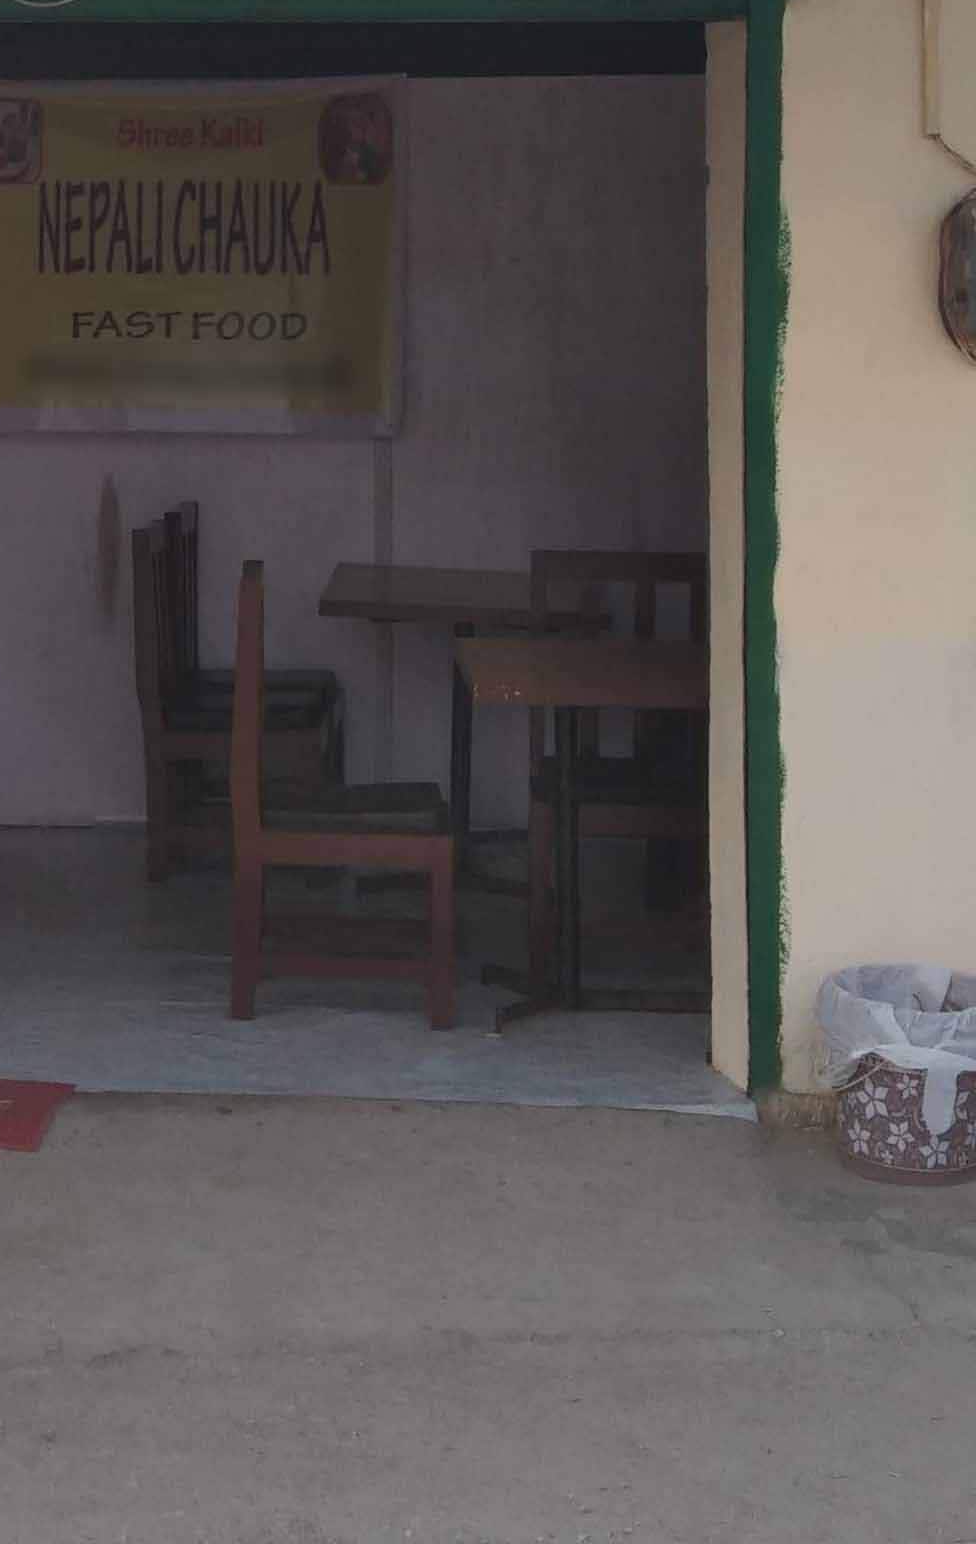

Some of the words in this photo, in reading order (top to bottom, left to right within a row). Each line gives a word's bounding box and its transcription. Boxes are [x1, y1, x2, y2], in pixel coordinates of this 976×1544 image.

[118, 119, 194, 149] Shree
[38, 179, 163, 274] NEPALI
[174, 178, 330, 275] CHAUKA
[71, 312, 183, 340] FAST
[191, 312, 308, 341] FOOD
